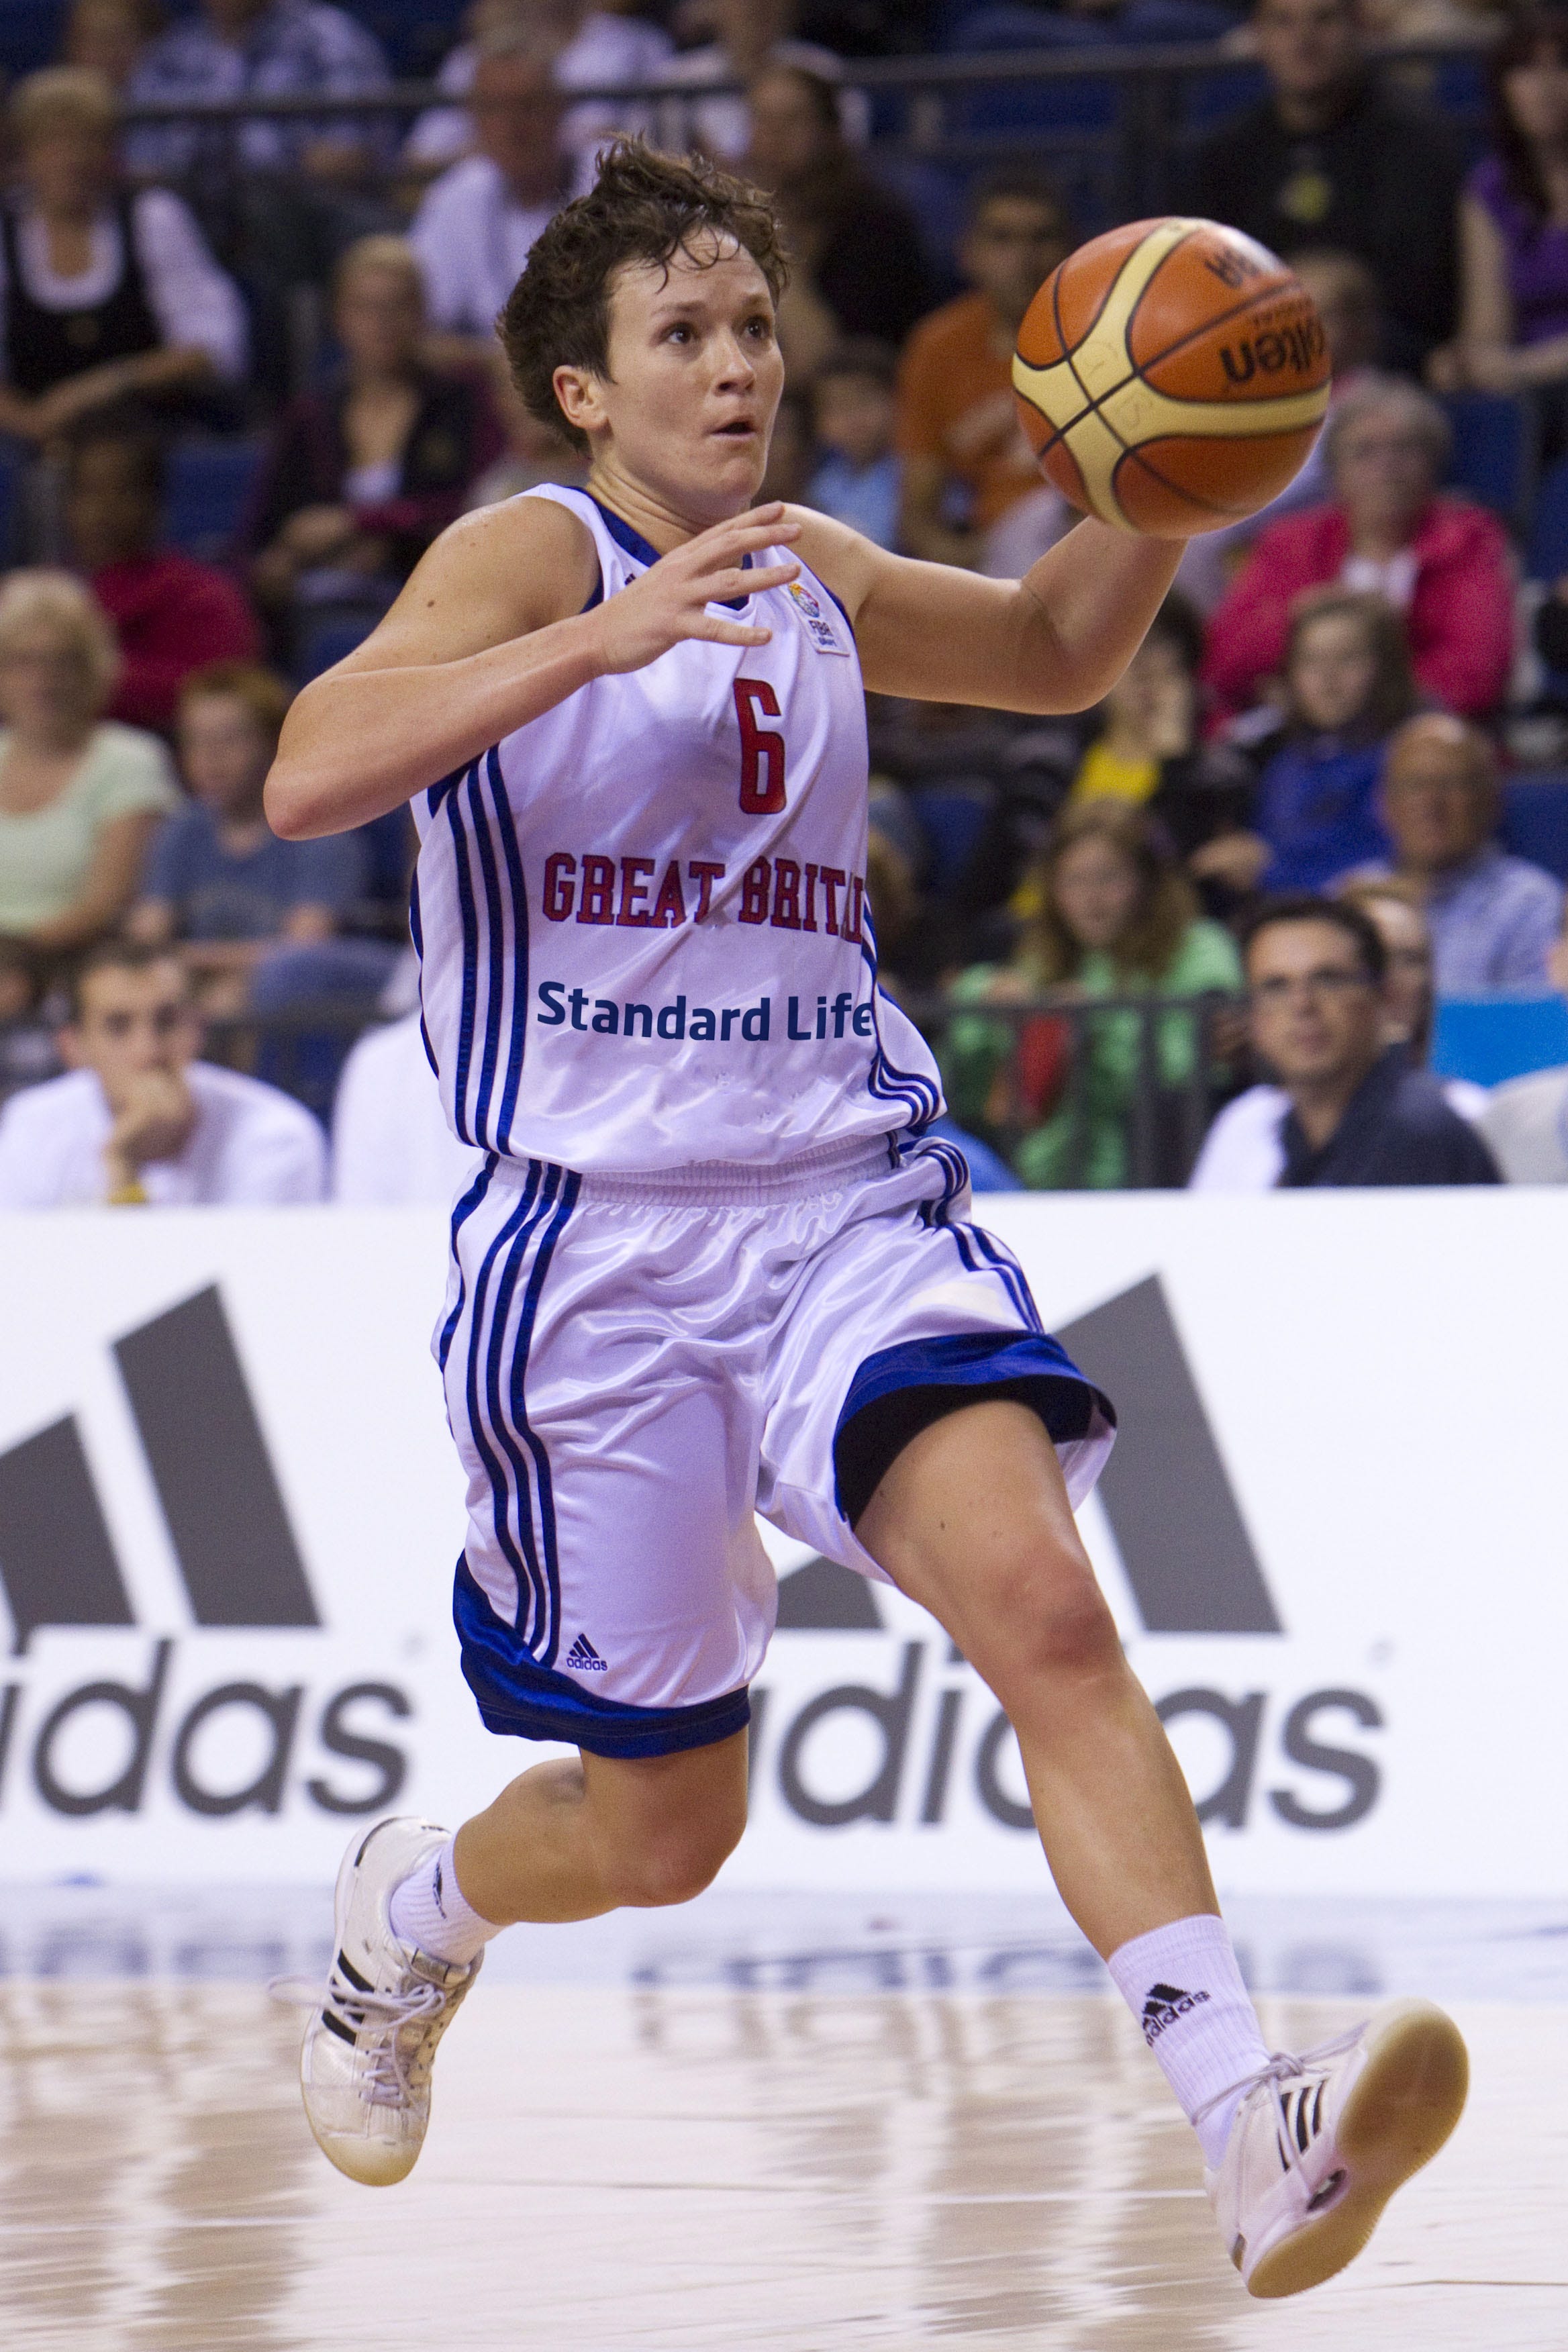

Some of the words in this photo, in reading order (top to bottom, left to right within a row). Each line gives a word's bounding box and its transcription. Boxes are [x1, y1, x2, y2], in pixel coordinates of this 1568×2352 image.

[734, 677, 787, 815] 6
[542, 852, 726, 929] GREAT
[536, 981, 771, 1042] Standard
[787, 992, 872, 1040] Life
[566, 1656, 608, 1671] adidas
[0, 1638, 416, 1816] idas
[1145, 1990, 1211, 2048] adidas
